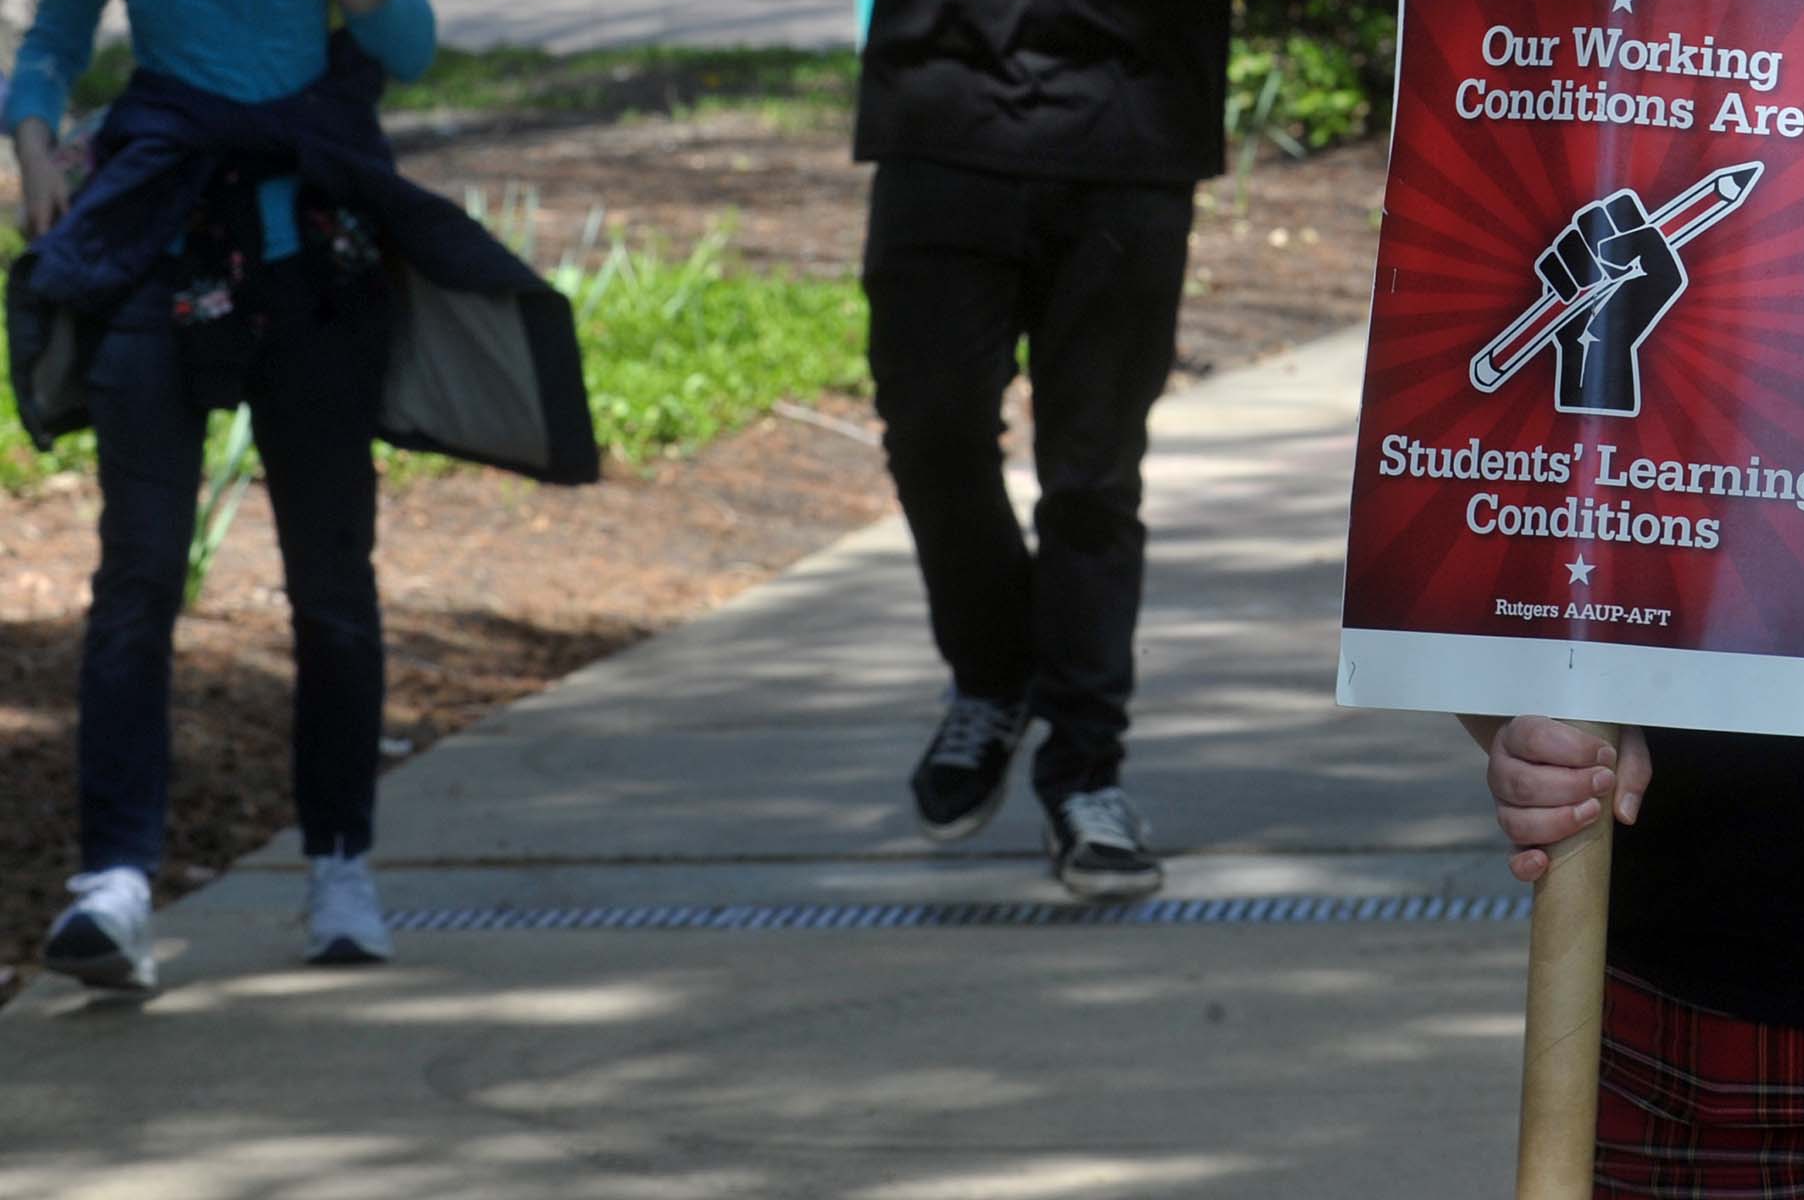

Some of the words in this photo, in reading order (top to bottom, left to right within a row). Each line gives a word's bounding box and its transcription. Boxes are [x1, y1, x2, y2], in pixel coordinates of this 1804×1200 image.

[1481, 24, 1560, 68] Our
[1572, 26, 1783, 92] Working
[1455, 78, 1695, 130] Conditions
[1378, 433, 1584, 485] Students'
[1465, 492, 1721, 550] Conditions
[1495, 598, 1560, 621] Rutgers
[1563, 601, 1672, 628] AAUP-AFT
